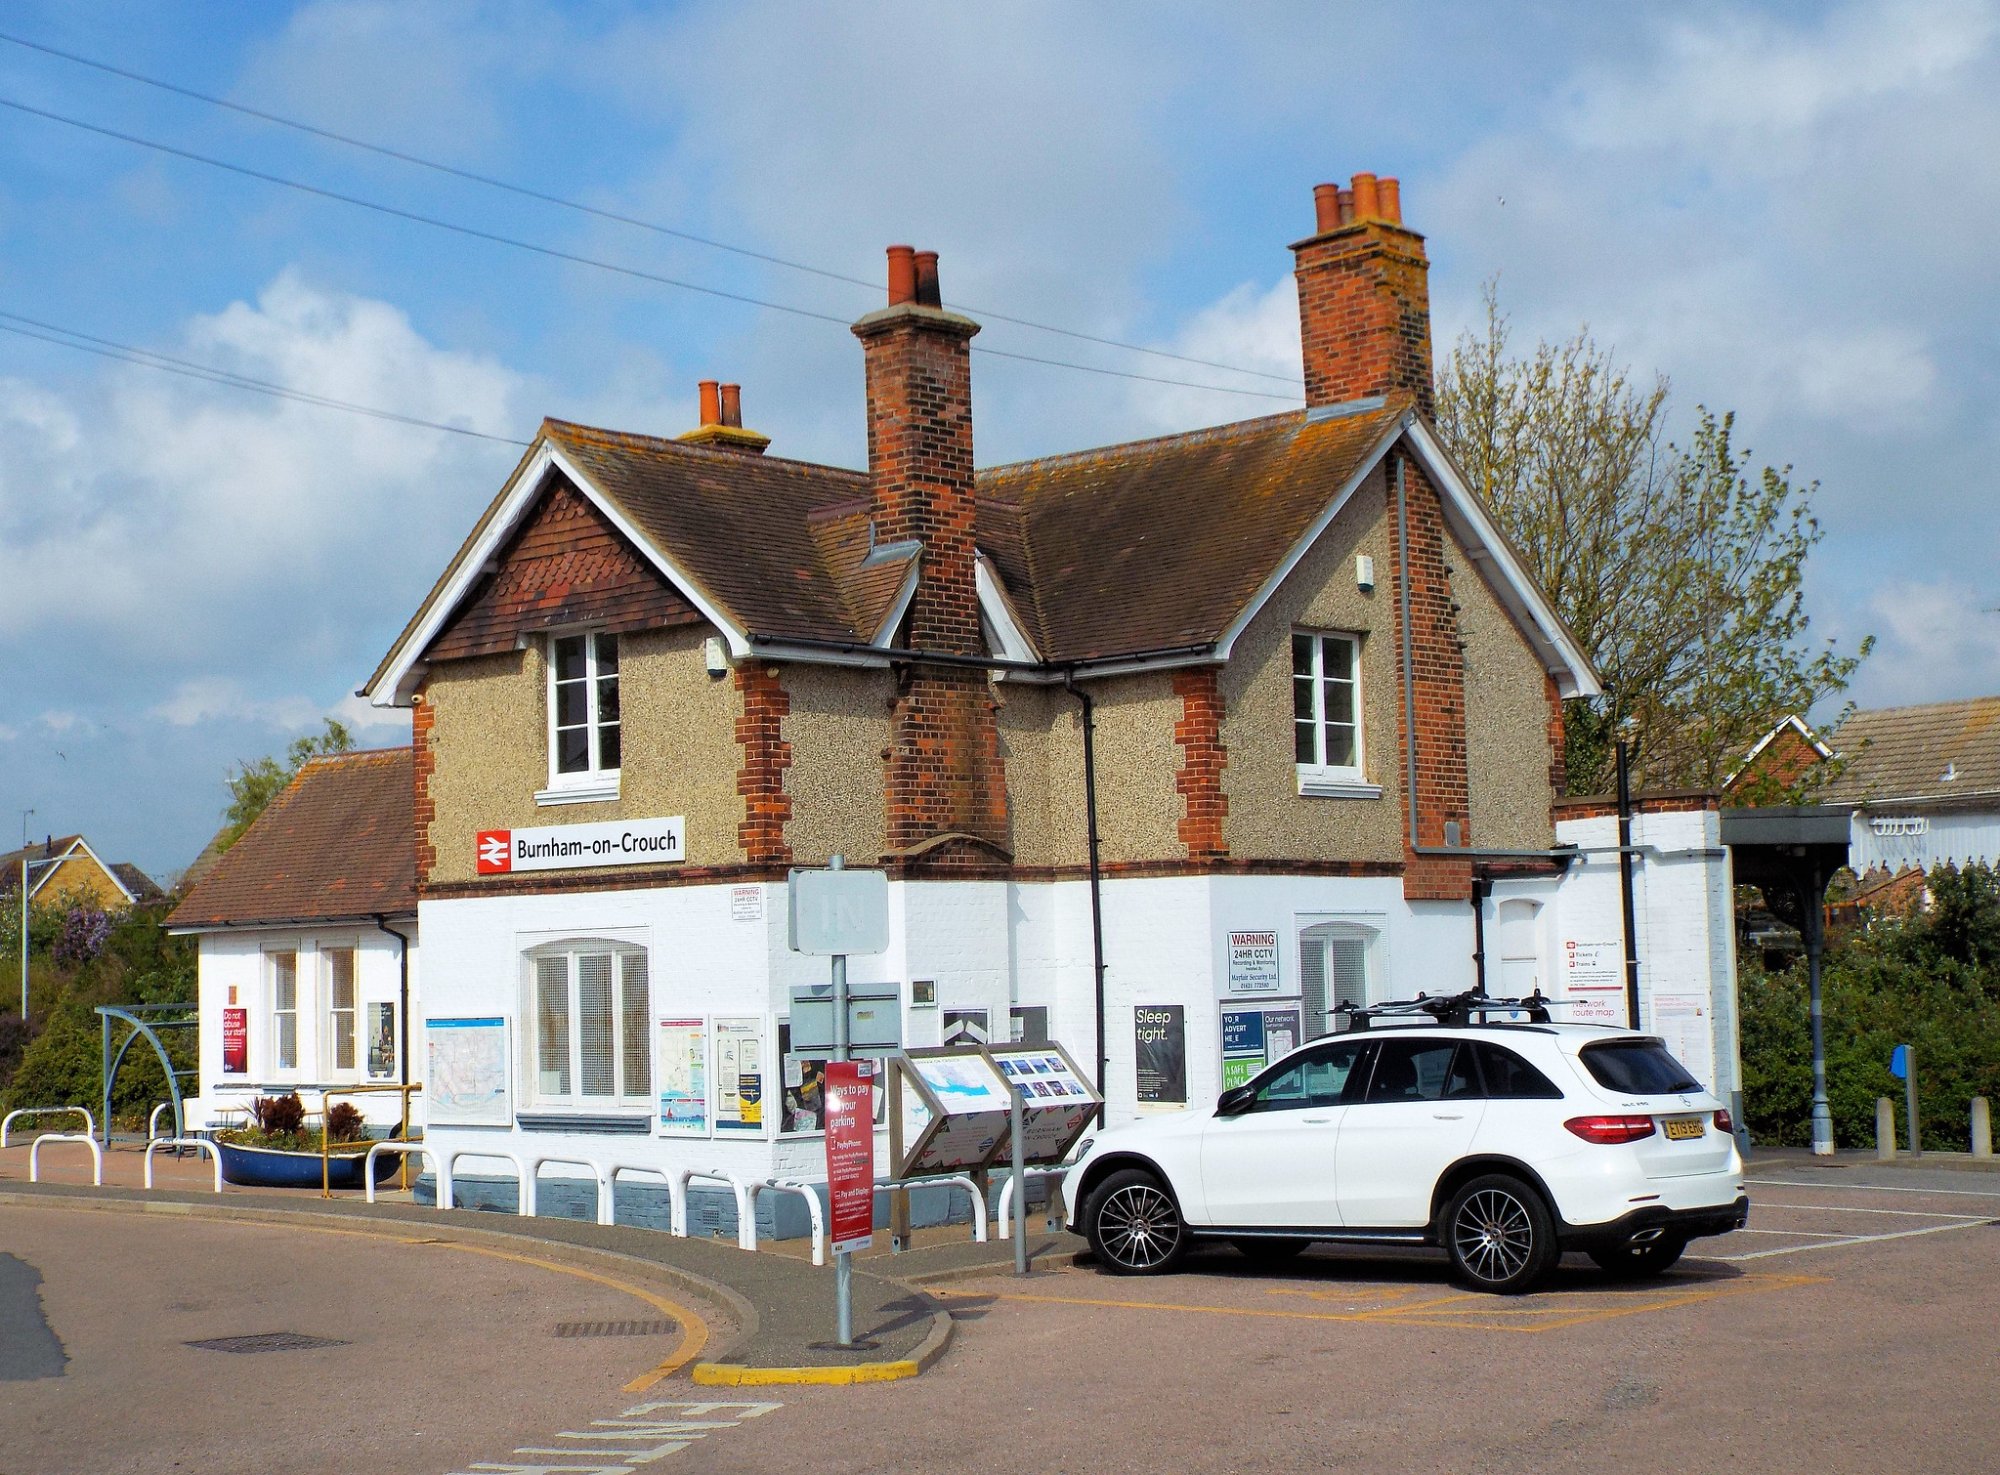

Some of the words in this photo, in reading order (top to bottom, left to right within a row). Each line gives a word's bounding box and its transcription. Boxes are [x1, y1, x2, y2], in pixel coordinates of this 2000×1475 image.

[518, 830, 676, 859] Burnham-on-Crouch
[1231, 934, 1275, 945] WARNING
[1234, 949, 1253, 958] 24HR
[1254, 949, 1273, 958] CCTV
[1136, 1009, 1171, 1026] Sleep
[1264, 1015, 1275, 1023] Our
[1573, 1009, 1594, 1017] route
[1595, 1009, 1615, 1017] map
[1136, 1026, 1168, 1043] tight.
[1224, 1025, 1246, 1033] ADVERT
[831, 1085, 848, 1098] Ways
[849, 1084, 857, 1095] to
[857, 1084, 870, 1097] pay
[841, 1101, 857, 1114] your
[830, 1115, 855, 1130] parking
[1669, 1120, 1688, 1135] ET19
